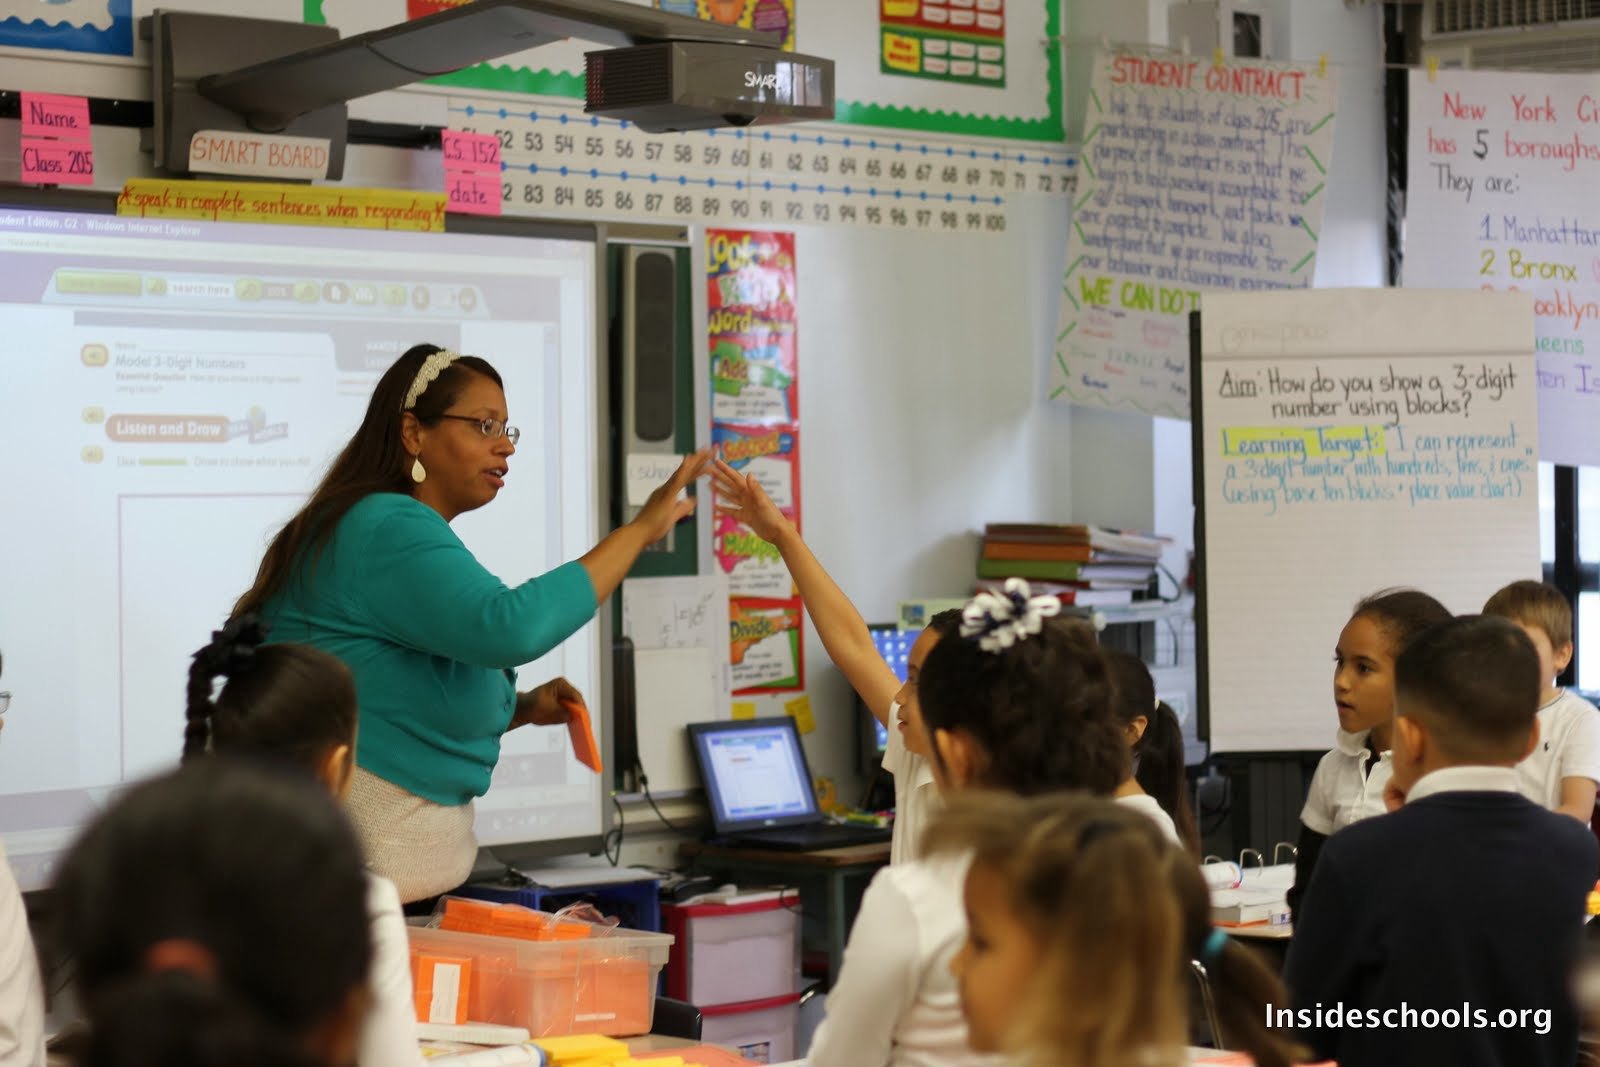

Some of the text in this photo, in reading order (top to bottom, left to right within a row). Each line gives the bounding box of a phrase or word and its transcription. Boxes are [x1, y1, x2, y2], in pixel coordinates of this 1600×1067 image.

[744, 71, 778, 89] SMAR
[1111, 56, 1305, 100] STUDENT CONTRACT
[30, 102, 78, 129] Name
[1443, 91, 1487, 121] New
[1511, 94, 1556, 122] York
[23, 149, 93, 175] Class 205
[192, 136, 327, 170] SMART BOARD
[472, 141, 499, 164] 152
[525, 132, 543, 151] 53
[555, 135, 573, 153] 54
[586, 137, 603, 156] 55
[616, 139, 633, 158] 56
[645, 142, 663, 160] 57
[675, 144, 692, 163] 58
[704, 147, 721, 165] 59
[731, 150, 750, 167] 60
[760, 152, 772, 169] 61
[788, 154, 802, 171] 62
[813, 156, 829, 173] 63
[839, 158, 856, 174] 64
[866, 160, 881, 177] 65
[890, 163, 906, 179] 66
[916, 164, 932, 181] 67
[942, 167, 957, 183] 68
[966, 169, 980, 185] 69
[990, 170, 1005, 187] 70
[1014, 172, 1025, 188] 71
[1039, 175, 1053, 192] 72
[1427, 127, 1600, 172] has 5 boroughs
[450, 180, 487, 205] date
[1430, 162, 1520, 203] They are:
[134, 190, 432, 230] speak in complete sentences when responding
[503, 185, 1005, 231] 2 83 84 85 86 87 88 89 90 91 92 93 94 95 96 97 98 99 100
[86, 219, 125, 232] Windows
[128, 222, 162, 234] Internet
[165, 223, 200, 236] Explorer
[1478, 213, 1497, 241] 1
[1480, 249, 1496, 276] 2
[1508, 248, 1577, 283] Bronx
[1078, 276, 1113, 305] WE
[1120, 281, 1154, 312] CAN
[1160, 287, 1184, 315] DO
[1534, 288, 1599, 331] ooklyn
[116, 354, 151, 367] Model
[196, 357, 246, 369] Numbers
[1535, 336, 1584, 355] eens
[1219, 362, 1517, 402] Aim: How do you show a 3-digit
[1272, 389, 1472, 427] number using blocks?
[116, 419, 156, 435] Listen
[159, 420, 184, 435] and
[188, 421, 221, 435] Draw
[1222, 427, 1307, 465] Learning
[1304, 426, 1378, 462] Target:
[1416, 435, 1441, 450] can
[1447, 423, 1517, 458] represent
[1226, 464, 1236, 480] a
[1302, 457, 1345, 477] number
[1354, 454, 1381, 476] with
[730, 618, 772, 639] Divide
